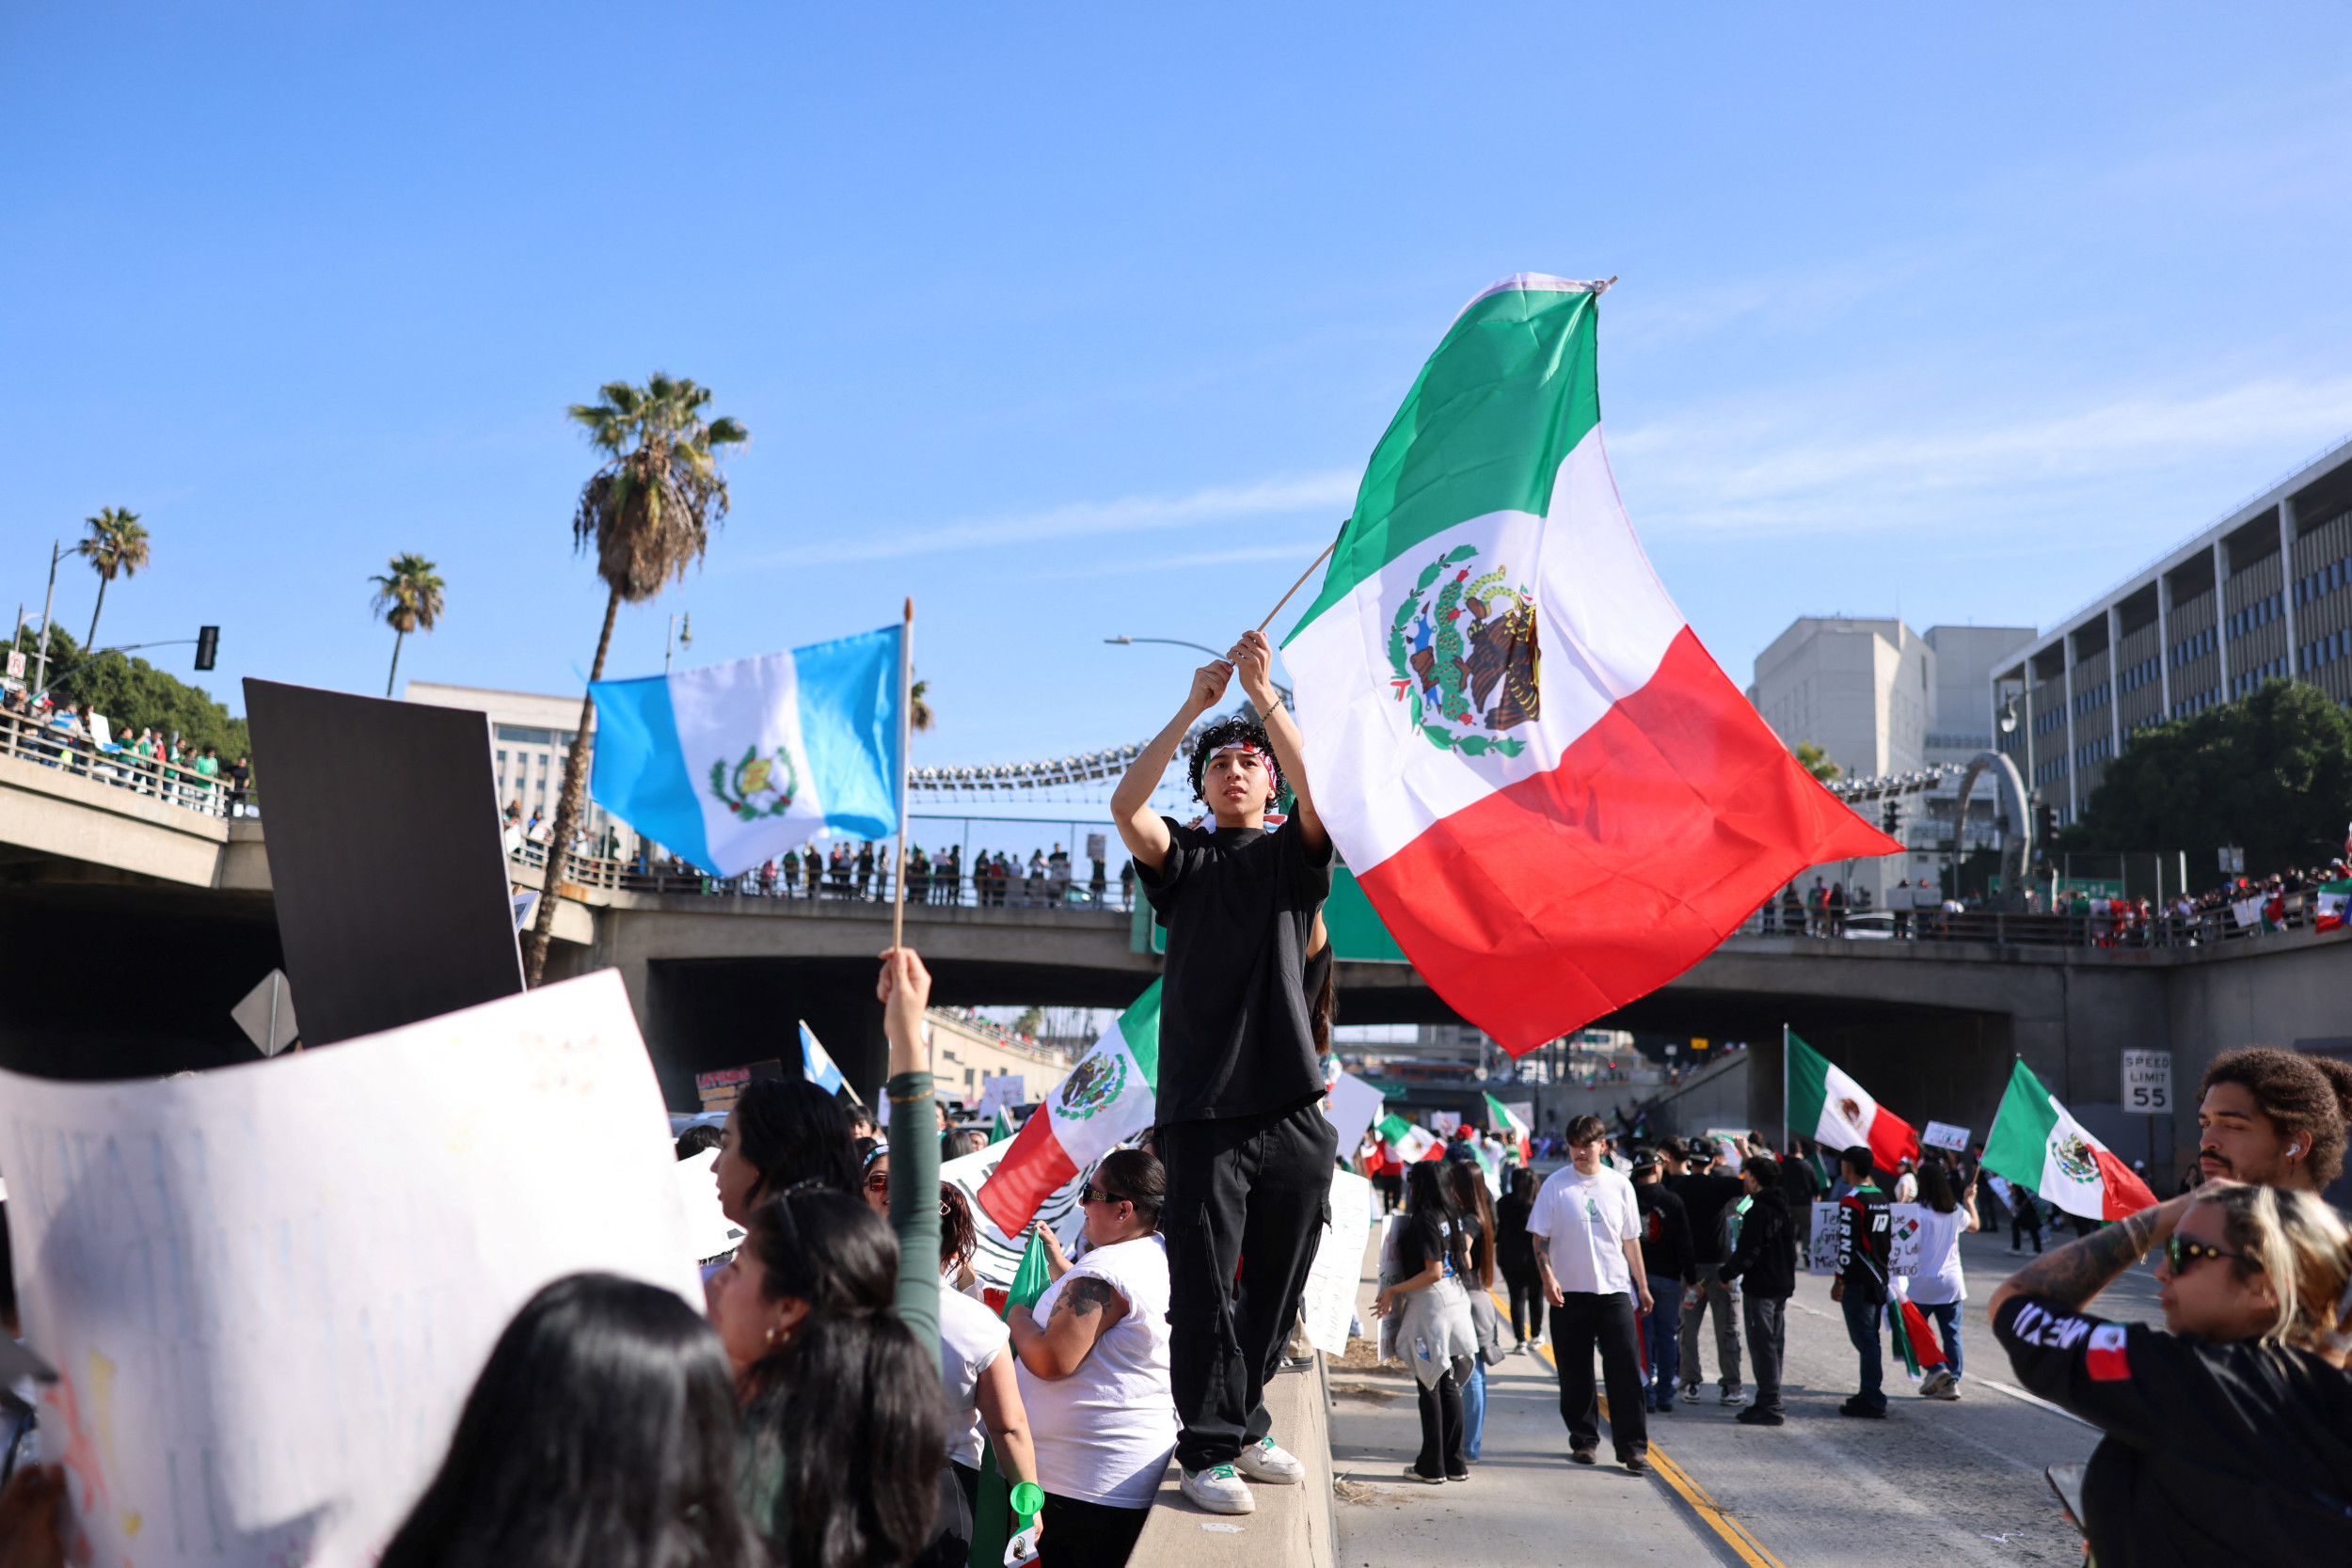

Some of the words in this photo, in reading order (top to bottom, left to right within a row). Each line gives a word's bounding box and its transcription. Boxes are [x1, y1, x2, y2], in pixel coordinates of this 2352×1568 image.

[2125, 1055, 2169, 1069] SPEED
[2130, 1071, 2166, 1084] LIMIT
[2134, 1087, 2166, 1107] 55
[1872, 1213, 1889, 1232] 10
